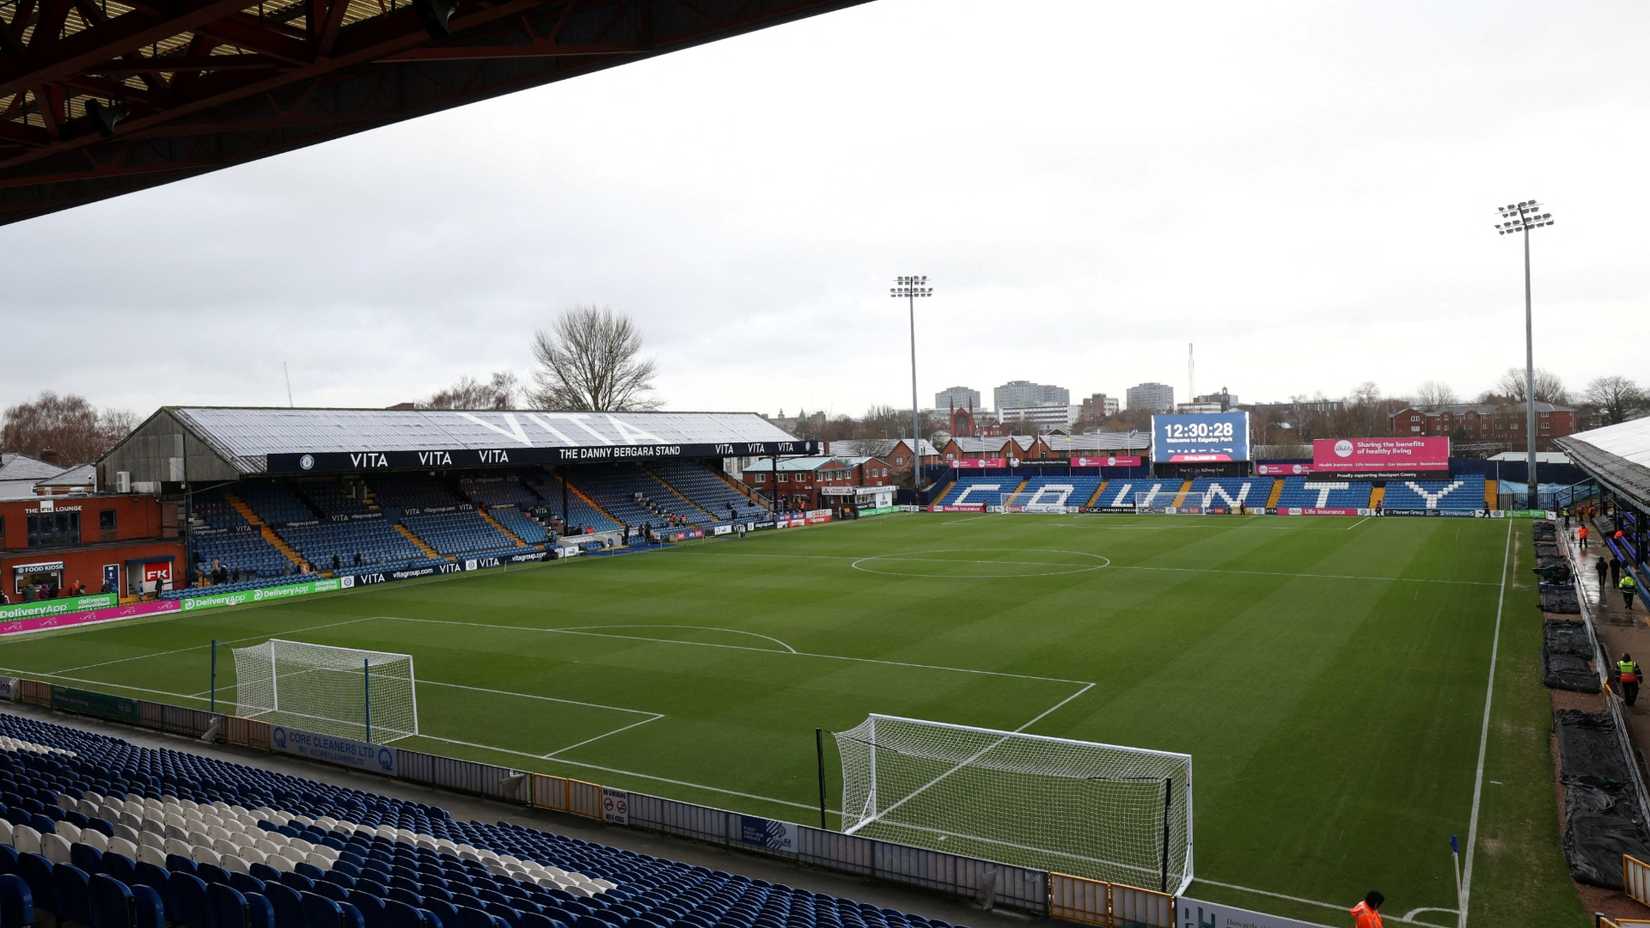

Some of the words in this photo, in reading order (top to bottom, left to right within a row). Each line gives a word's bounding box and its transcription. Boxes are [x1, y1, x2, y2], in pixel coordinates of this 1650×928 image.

[457, 412, 667, 447] VITA
[1164, 422, 1233, 437] 12:30:28
[715, 444, 734, 455] VITA
[747, 443, 765, 454] VITA
[778, 442, 794, 452] VITA
[1356, 441, 1381, 449] Sharing
[1392, 447, 1412, 455] living
[418, 451, 452, 466] VITA
[478, 450, 509, 463] VITA
[559, 449, 578, 459] THE
[580, 447, 612, 458] DANNY
[614, 446, 654, 457] BERGARA
[655, 446, 681, 456] STAND
[350, 453, 388, 468] VITA
[405, 507, 420, 516] VITA
[439, 562, 461, 574] VITA
[479, 557, 500, 568] VITA
[146, 570, 168, 581] FK
[360, 573, 385, 584] VITA
[392, 567, 433, 579] vitagroup.com
[263, 585, 309, 598] DeliveryApp
[194, 593, 246, 607] DeliveryApp
[0, 604, 68, 619] DeliveryApp
[289, 731, 312, 745] CORE
[312, 735, 357, 757] CLEANERS
[359, 745, 376, 758] LTD
